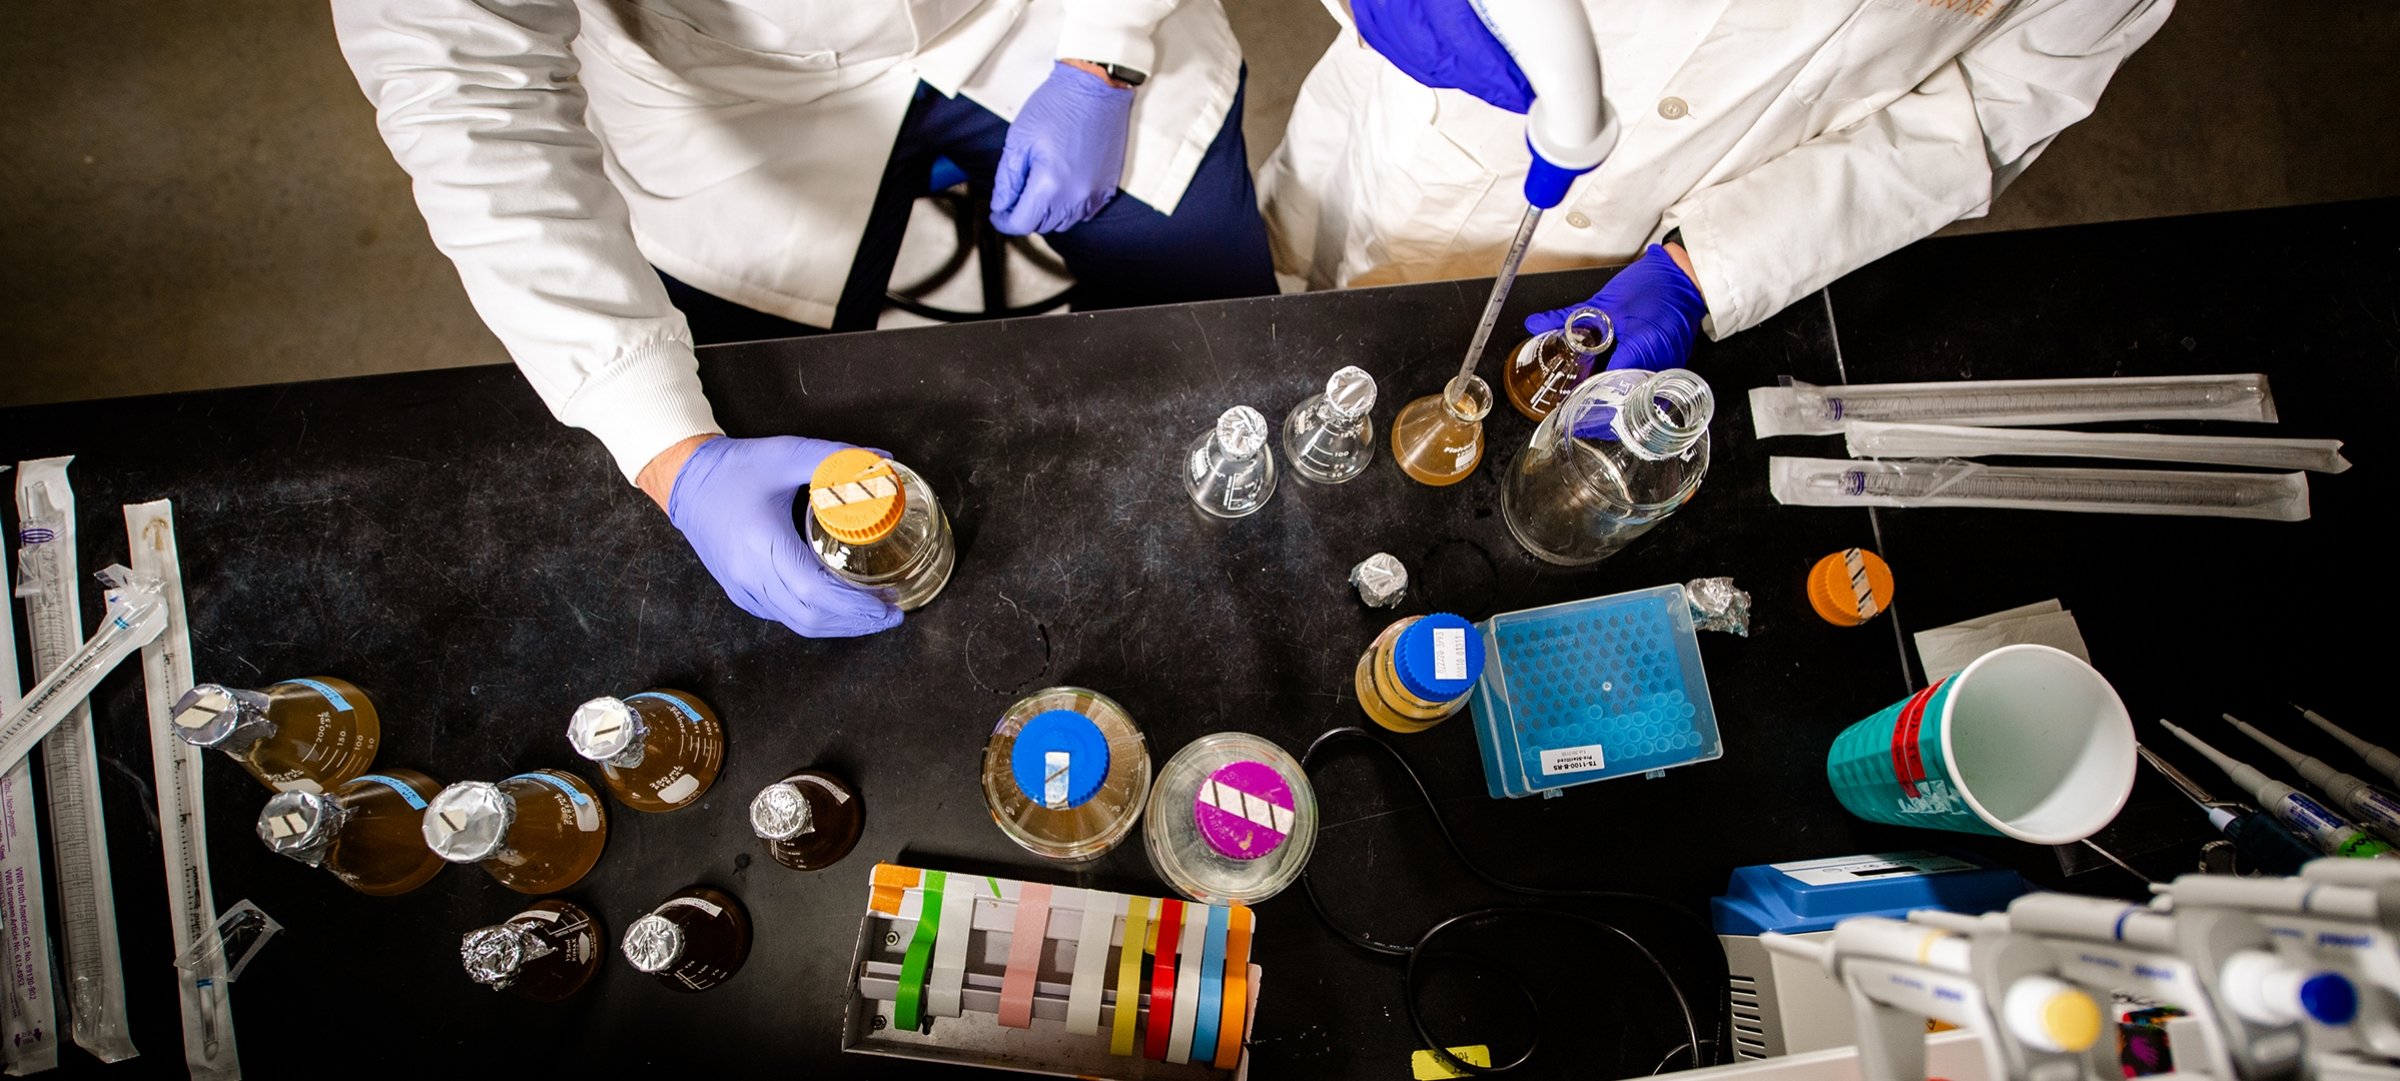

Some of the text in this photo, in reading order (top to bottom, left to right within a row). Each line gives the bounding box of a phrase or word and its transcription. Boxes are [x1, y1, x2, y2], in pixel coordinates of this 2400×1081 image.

[337, 730, 347, 746] 150
[354, 735, 364, 751] 100
[5, 869, 14, 886] VWR
[6, 887, 17, 919] European
[10, 919, 19, 941] Article
[15, 866, 37, 1001] VWR North American Cat. No. 89130-902
[13, 941, 21, 953] No.
[14, 953, 25, 987] 612-4953
